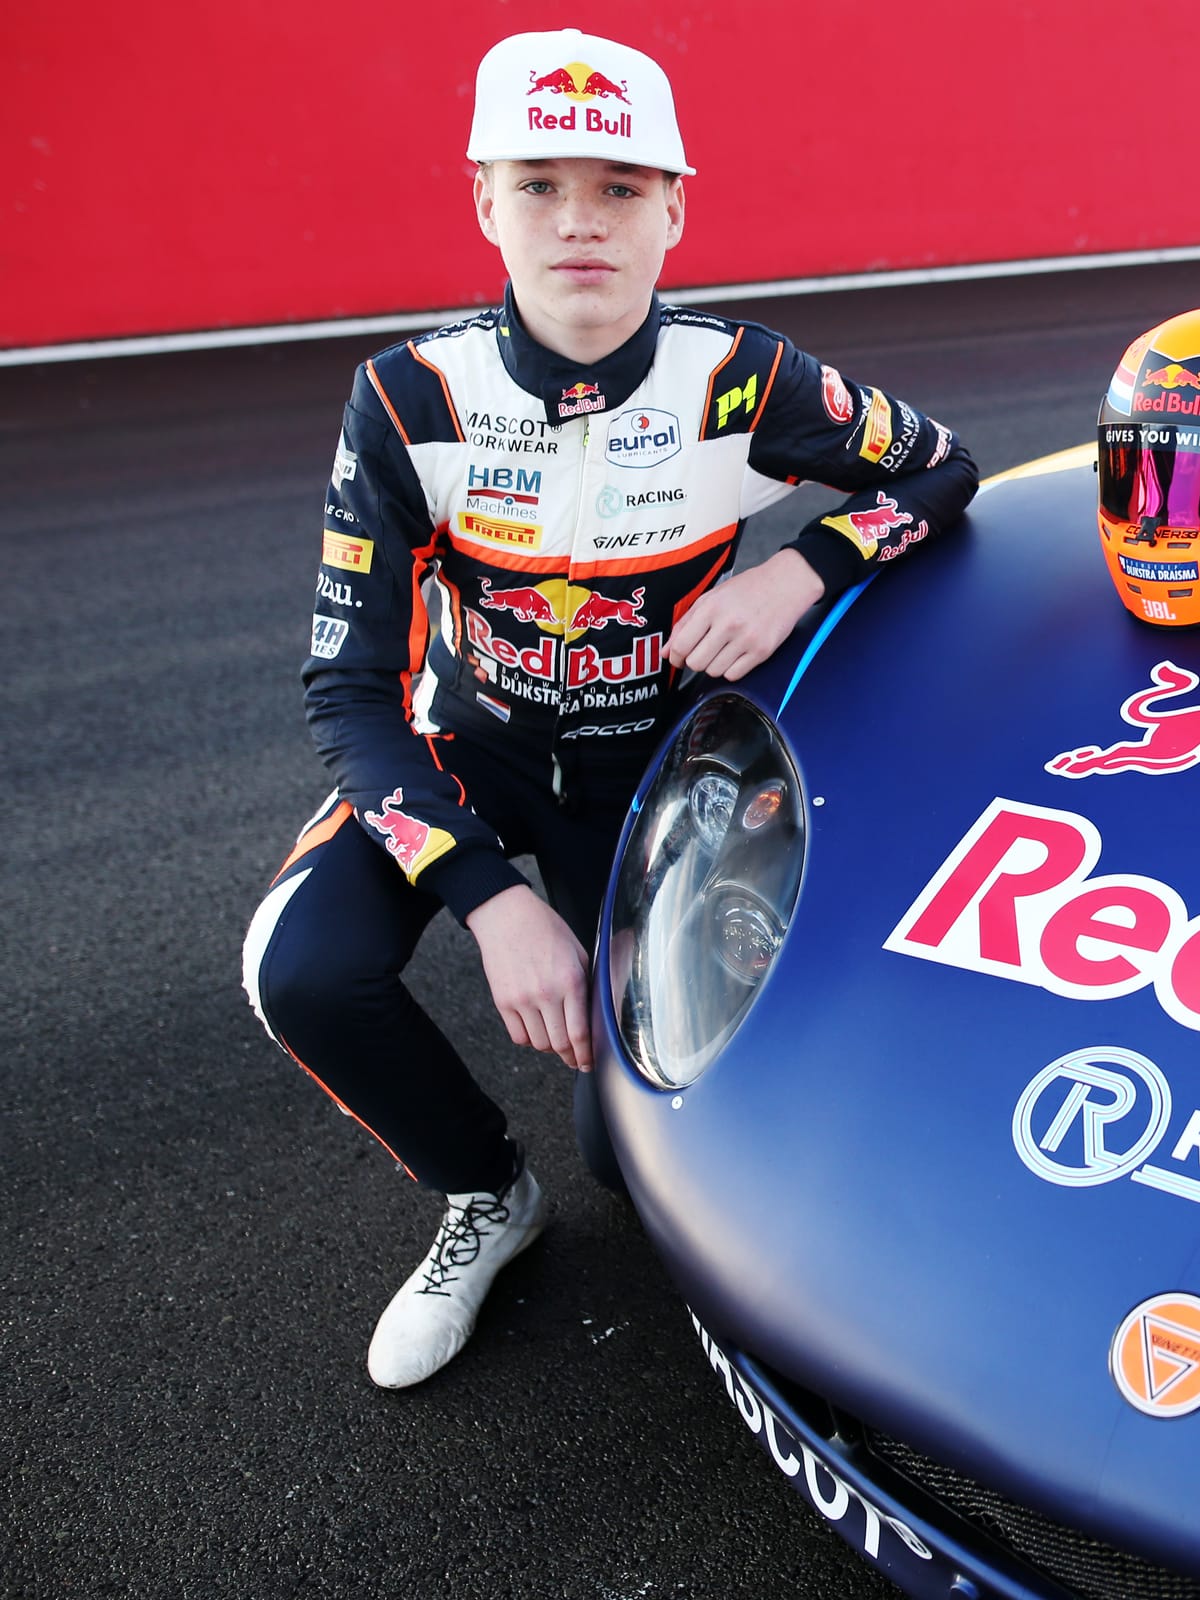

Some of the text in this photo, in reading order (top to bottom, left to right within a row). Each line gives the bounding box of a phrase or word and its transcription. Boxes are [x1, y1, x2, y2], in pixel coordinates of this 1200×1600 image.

[528, 106, 631, 138] Red Bull
[558, 395, 606, 417] Red Bull
[1133, 392, 1166, 411] Red
[469, 432, 558, 454] ORKWEAR
[609, 426, 675, 451] eurol
[1106, 430, 1134, 443] GIVES
[1138, 430, 1170, 444] YOU
[468, 464, 542, 493] HBM
[466, 498, 537, 520] Machines
[465, 516, 535, 544] PIRELLI
[593, 524, 685, 549] GINETTA
[877, 520, 928, 562] Red Bull
[1141, 599, 1177, 620] JBL
[463, 605, 663, 691] Red Bull
